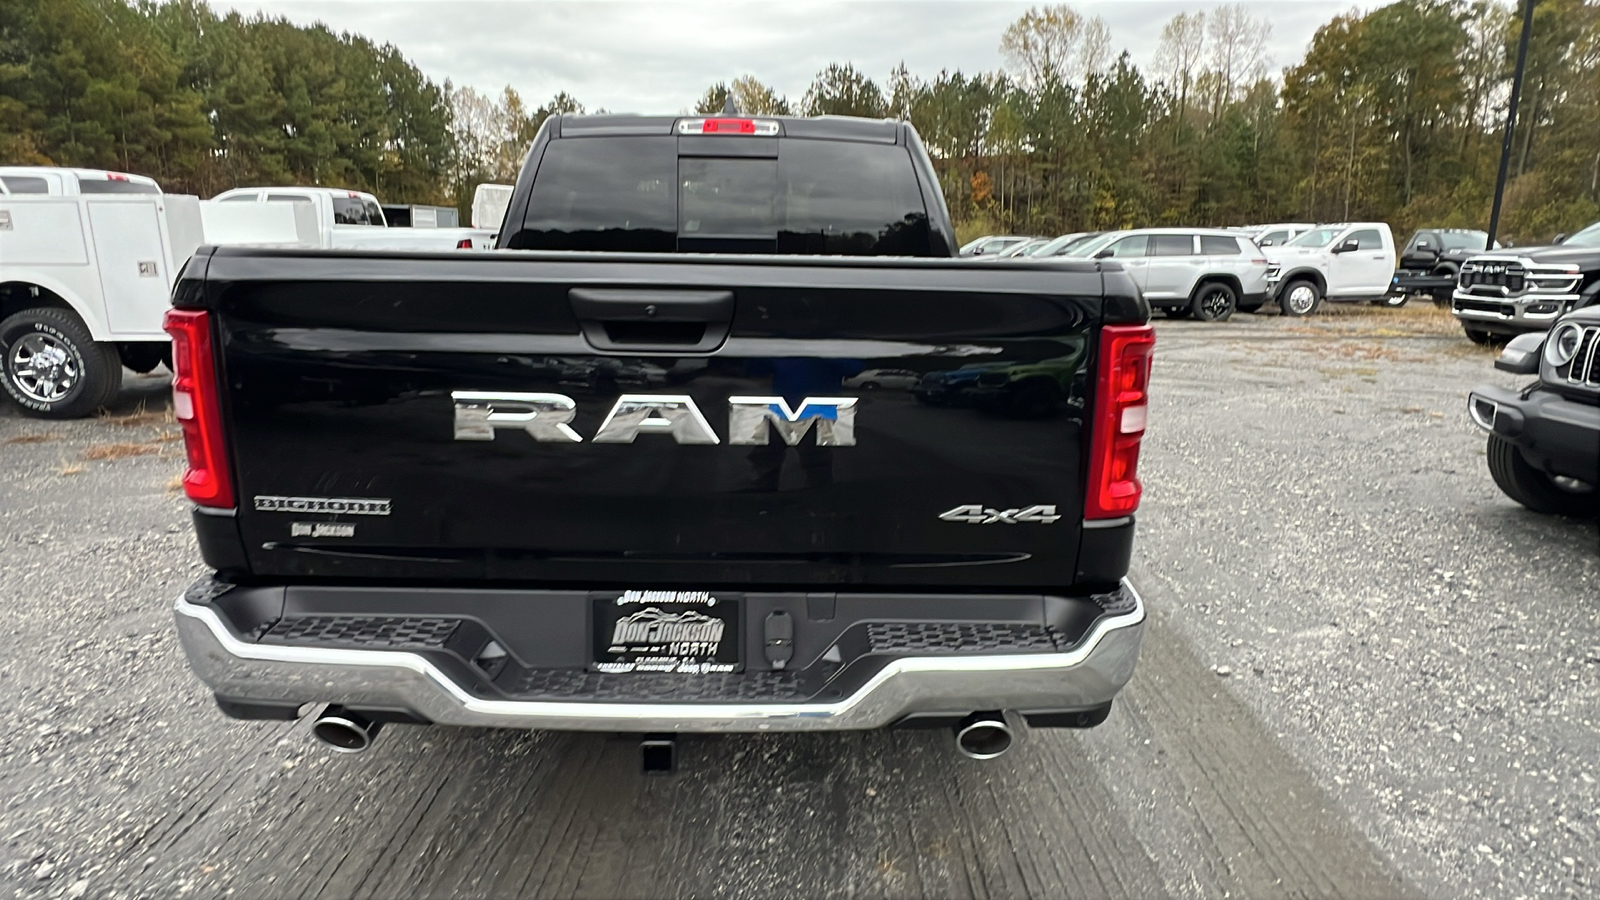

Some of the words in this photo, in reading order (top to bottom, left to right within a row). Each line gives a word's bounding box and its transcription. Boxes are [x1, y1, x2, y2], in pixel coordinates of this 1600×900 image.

[451, 391, 859, 446] RAM
[676, 591, 709, 604] NORTH
[669, 642, 718, 656] NORTH
